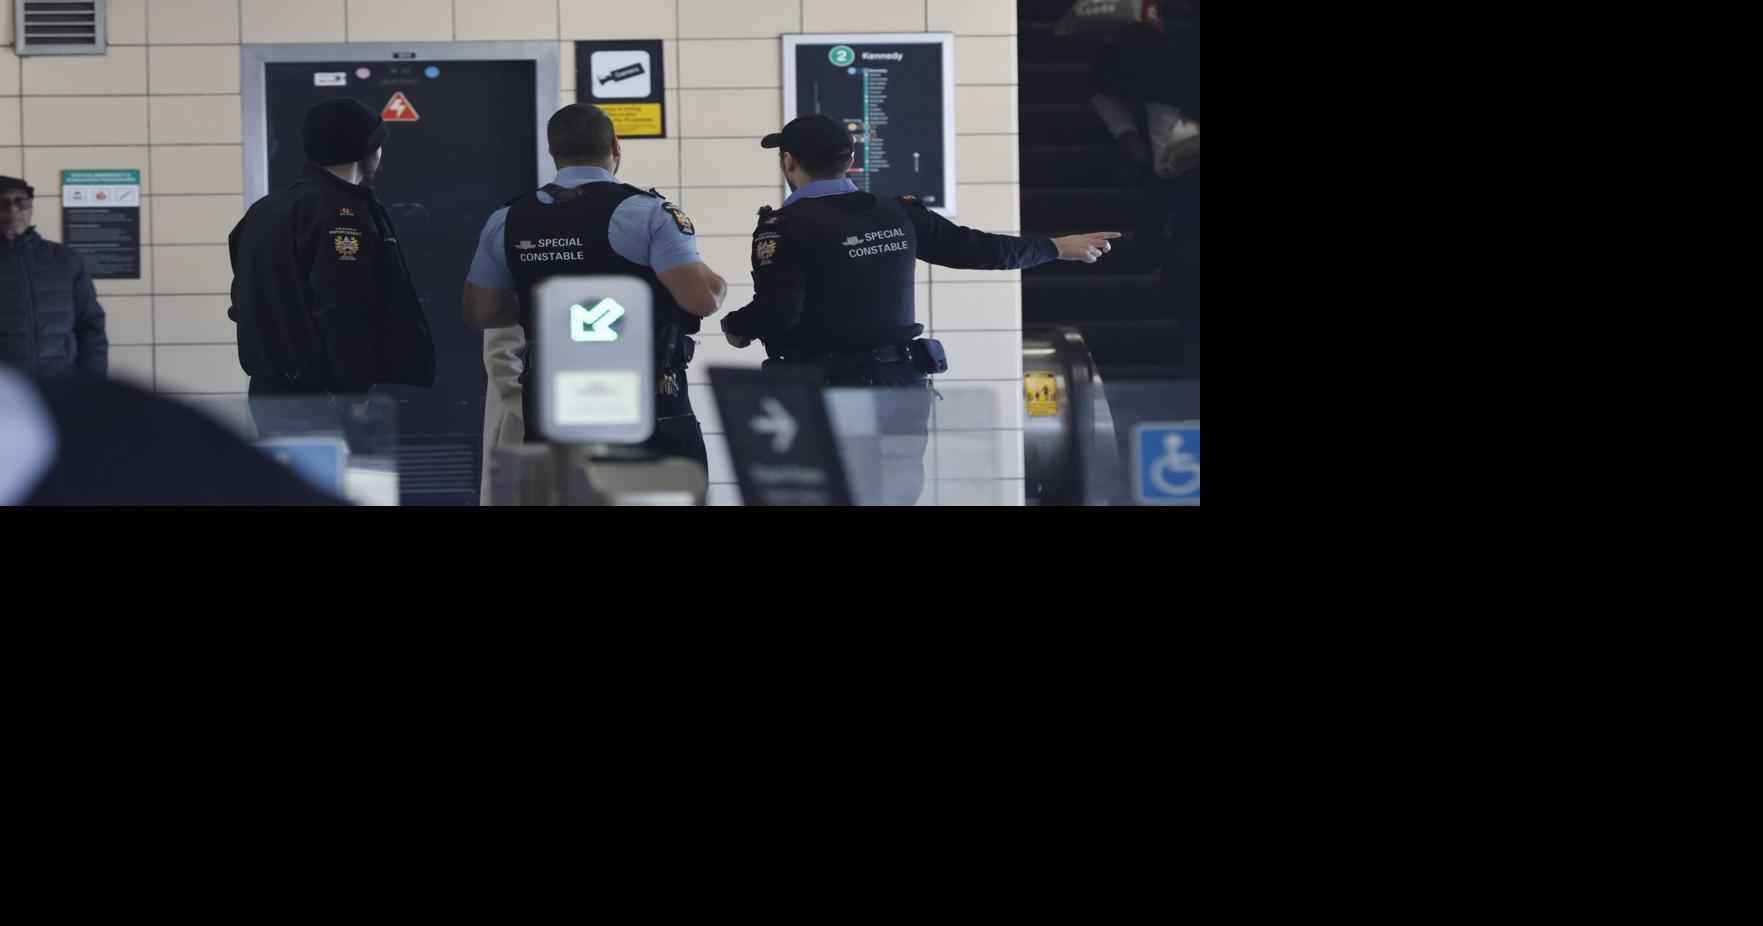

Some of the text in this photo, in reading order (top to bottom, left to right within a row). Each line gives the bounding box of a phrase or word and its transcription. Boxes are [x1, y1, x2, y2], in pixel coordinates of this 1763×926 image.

[836, 50, 903, 62] 2 Kennedy
[864, 227, 905, 242] SPECIAL
[538, 237, 583, 248] SPECIAL
[848, 240, 908, 258] CONSTABLE
[520, 251, 584, 262] CONSTABLE
